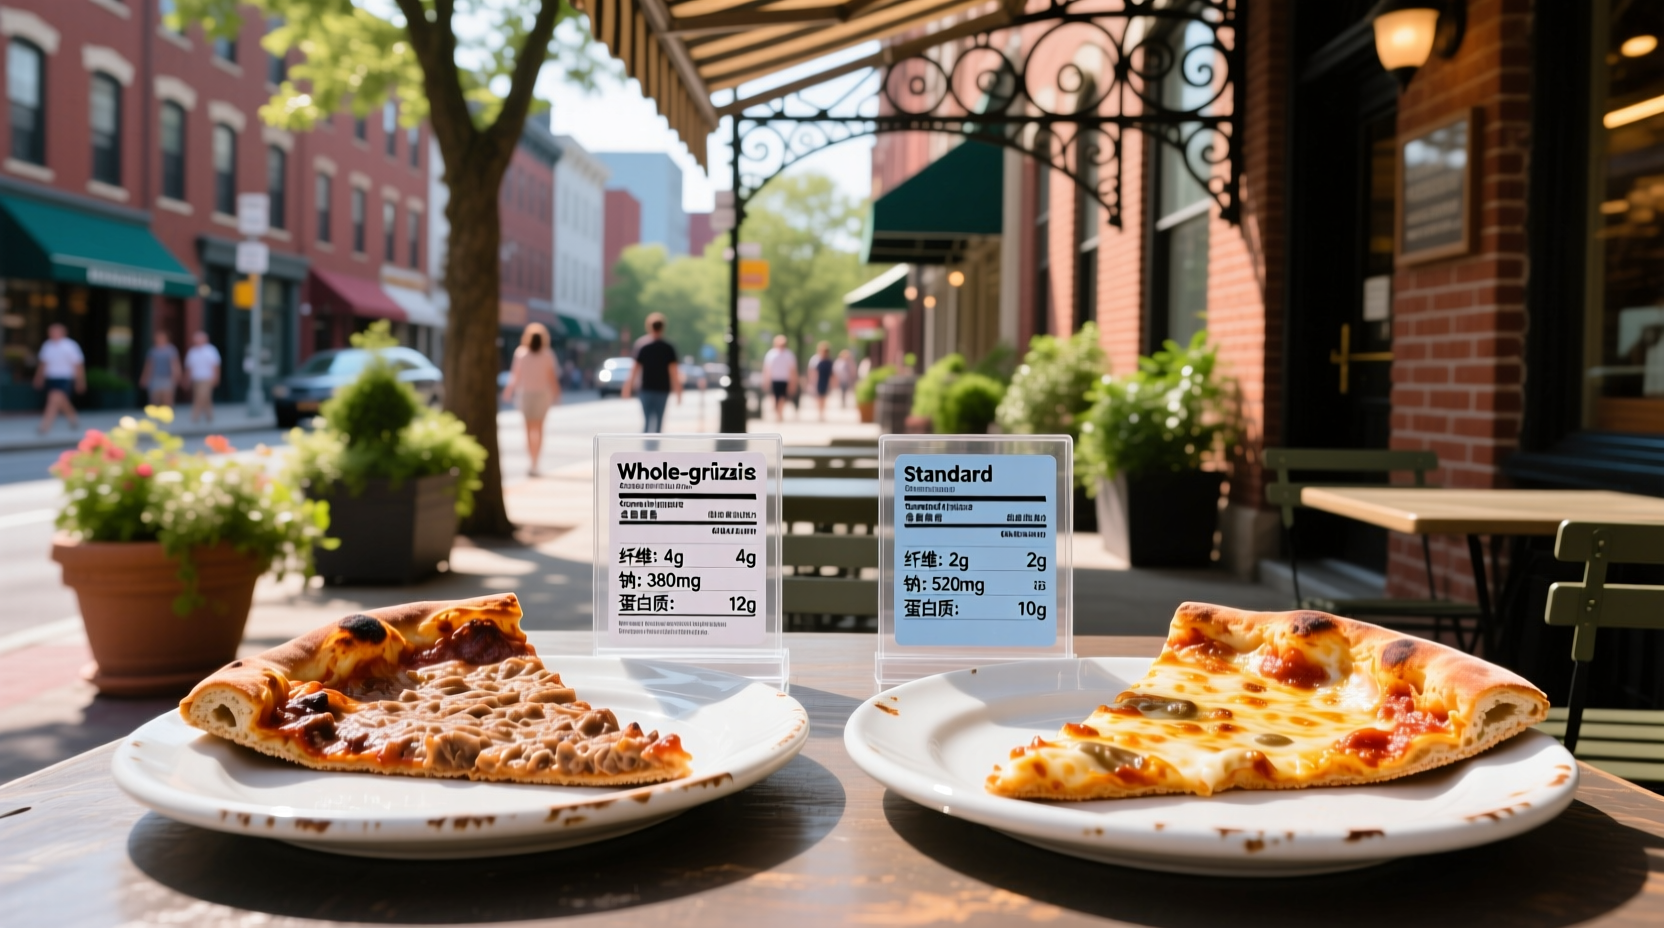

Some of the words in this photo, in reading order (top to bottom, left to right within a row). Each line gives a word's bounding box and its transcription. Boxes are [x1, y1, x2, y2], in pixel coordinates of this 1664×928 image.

[904, 464, 993, 483] Standard
[663, 548, 684, 568] 4g
[735, 548, 756, 568] 4g
[903, 550, 943, 569] 纤维:
[948, 552, 969, 571] 2g
[1026, 552, 1047, 571] 2g
[618, 570, 642, 590] 钠:
[646, 572, 701, 592] 380mg
[903, 574, 927, 593] 钠:
[931, 576, 985, 596] 520mg
[618, 593, 675, 612] 蛋白质:
[729, 596, 756, 614] 12g
[903, 598, 959, 618] 蛋白质:
[1018, 601, 1047, 620] 10g
